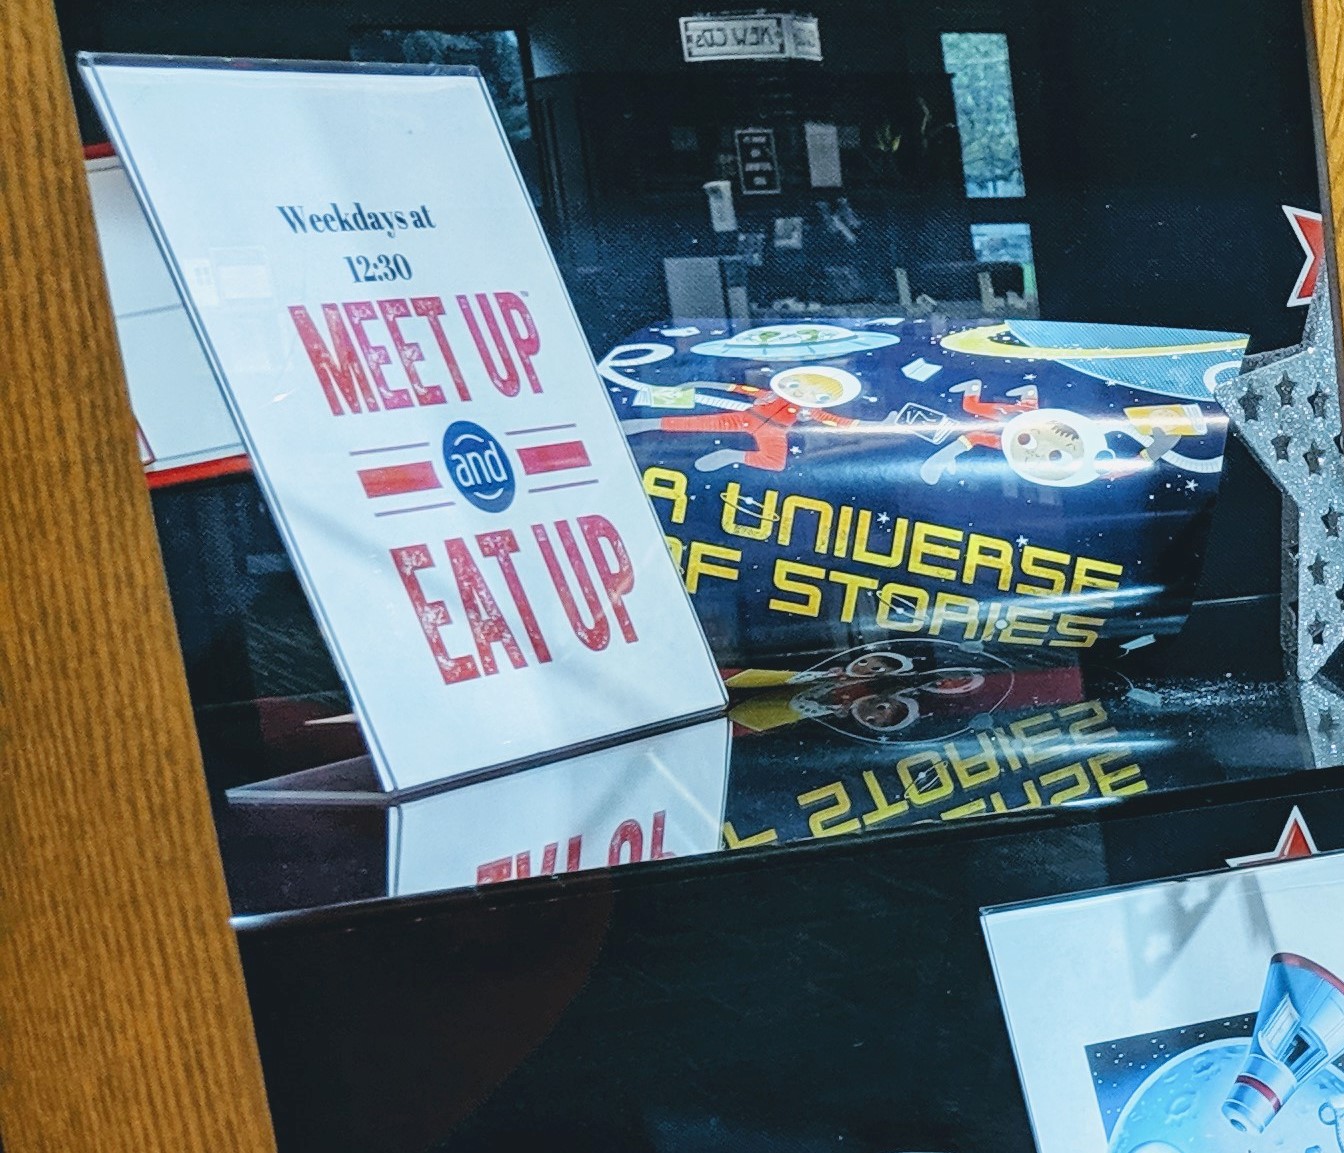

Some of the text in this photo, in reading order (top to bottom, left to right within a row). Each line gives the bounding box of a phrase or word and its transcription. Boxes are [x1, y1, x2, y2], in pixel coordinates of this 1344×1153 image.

[277, 204, 436, 238] Weekdays at
[343, 253, 413, 284] 12:30
[287, 291, 543, 416] MEET UP
[450, 440, 508, 489] and
[643, 466, 1124, 610] A UNIVERSE
[389, 513, 639, 685] EAT UP
[768, 559, 1107, 649] STORIES
